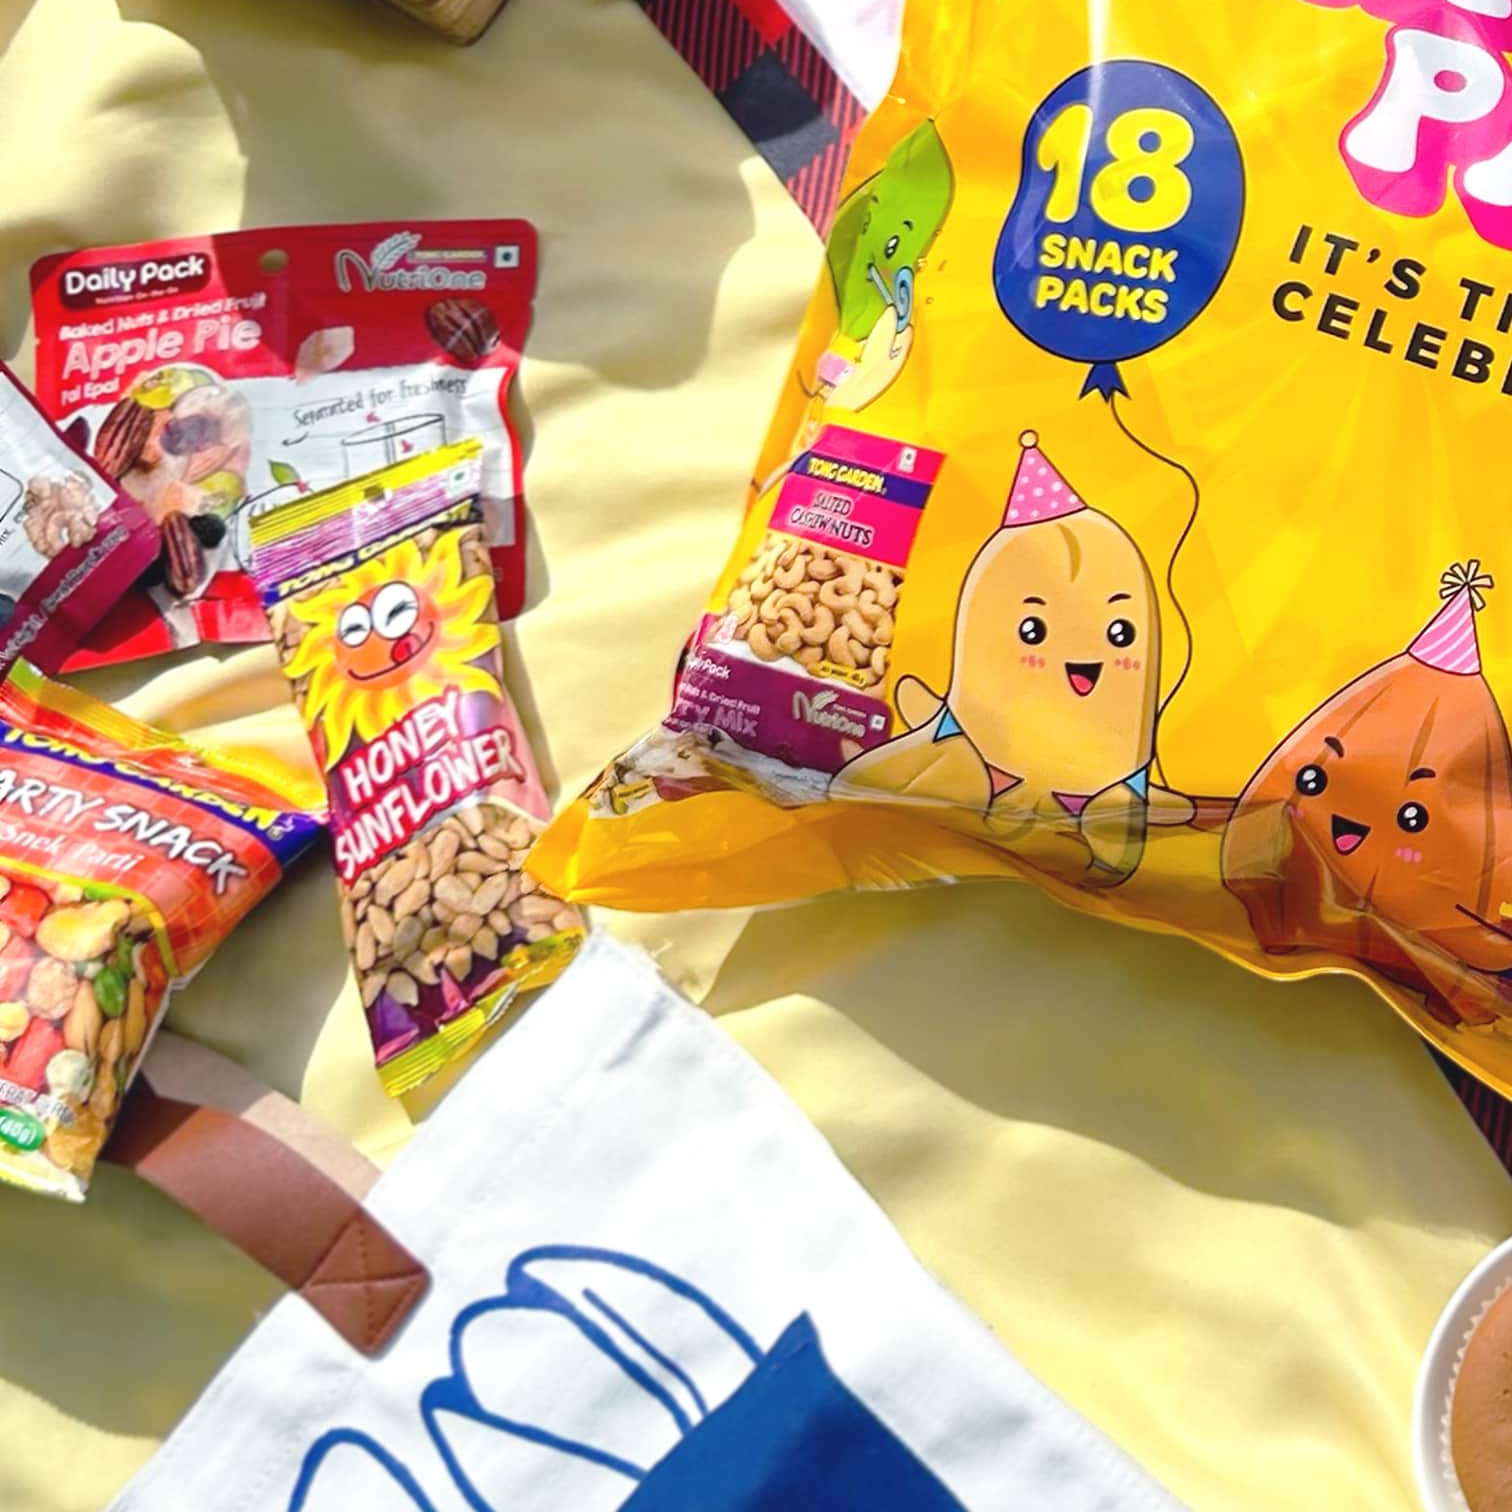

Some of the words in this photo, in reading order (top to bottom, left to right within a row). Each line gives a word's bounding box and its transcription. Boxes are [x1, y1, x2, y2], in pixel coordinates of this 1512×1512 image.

[1036, 102, 1196, 233] 18
[65, 267, 137, 295] Daily
[140, 255, 205, 286] Pack
[1038, 232, 1179, 283] SNACK
[58, 319, 115, 341] Baked
[116, 310, 155, 332] Nuts
[172, 299, 225, 322] Dried
[224, 292, 268, 312] Fruit
[1034, 274, 1170, 324] PACKS
[62, 327, 184, 380] Apple
[192, 315, 263, 355] Pie
[369, 387, 393, 408] for
[831, 518, 873, 545] NUTS
[343, 690, 460, 804] HONEY
[336, 728, 525, 879] SUNFLOWER
[74, 841, 144, 872] Parti
[94, 805, 248, 895] SNACK
